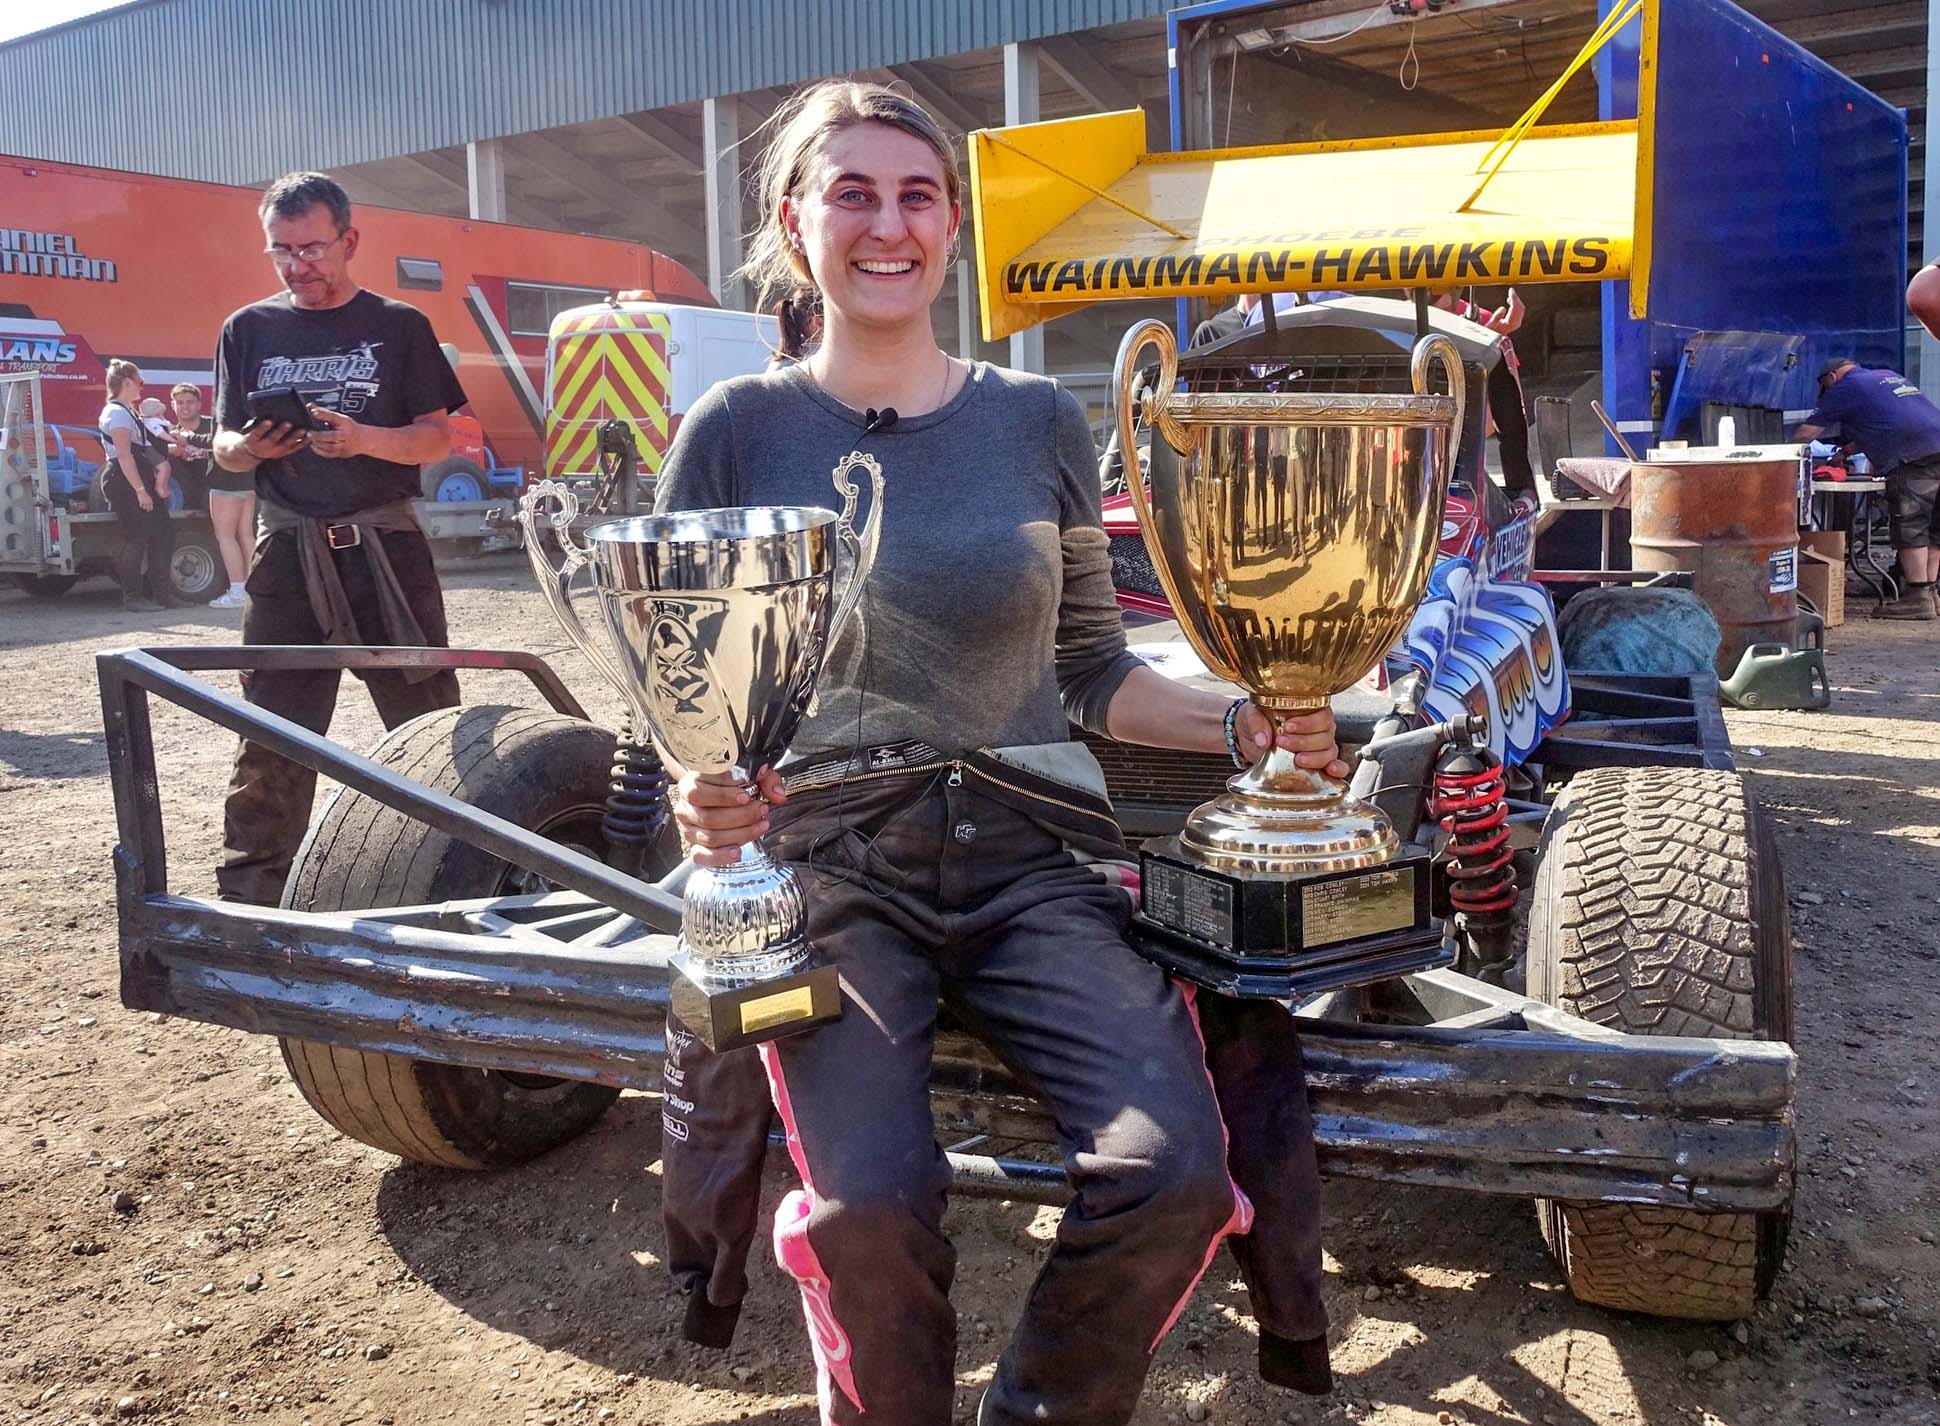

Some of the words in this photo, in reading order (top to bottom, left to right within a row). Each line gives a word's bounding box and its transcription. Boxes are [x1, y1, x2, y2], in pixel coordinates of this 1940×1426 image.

[1197, 227, 1426, 247] PHOEBE
[1007, 237, 1610, 293] WAINMAN-HAWKINS
[257, 356, 379, 389] HARRIS
[669, 1092, 695, 1115] Shop
